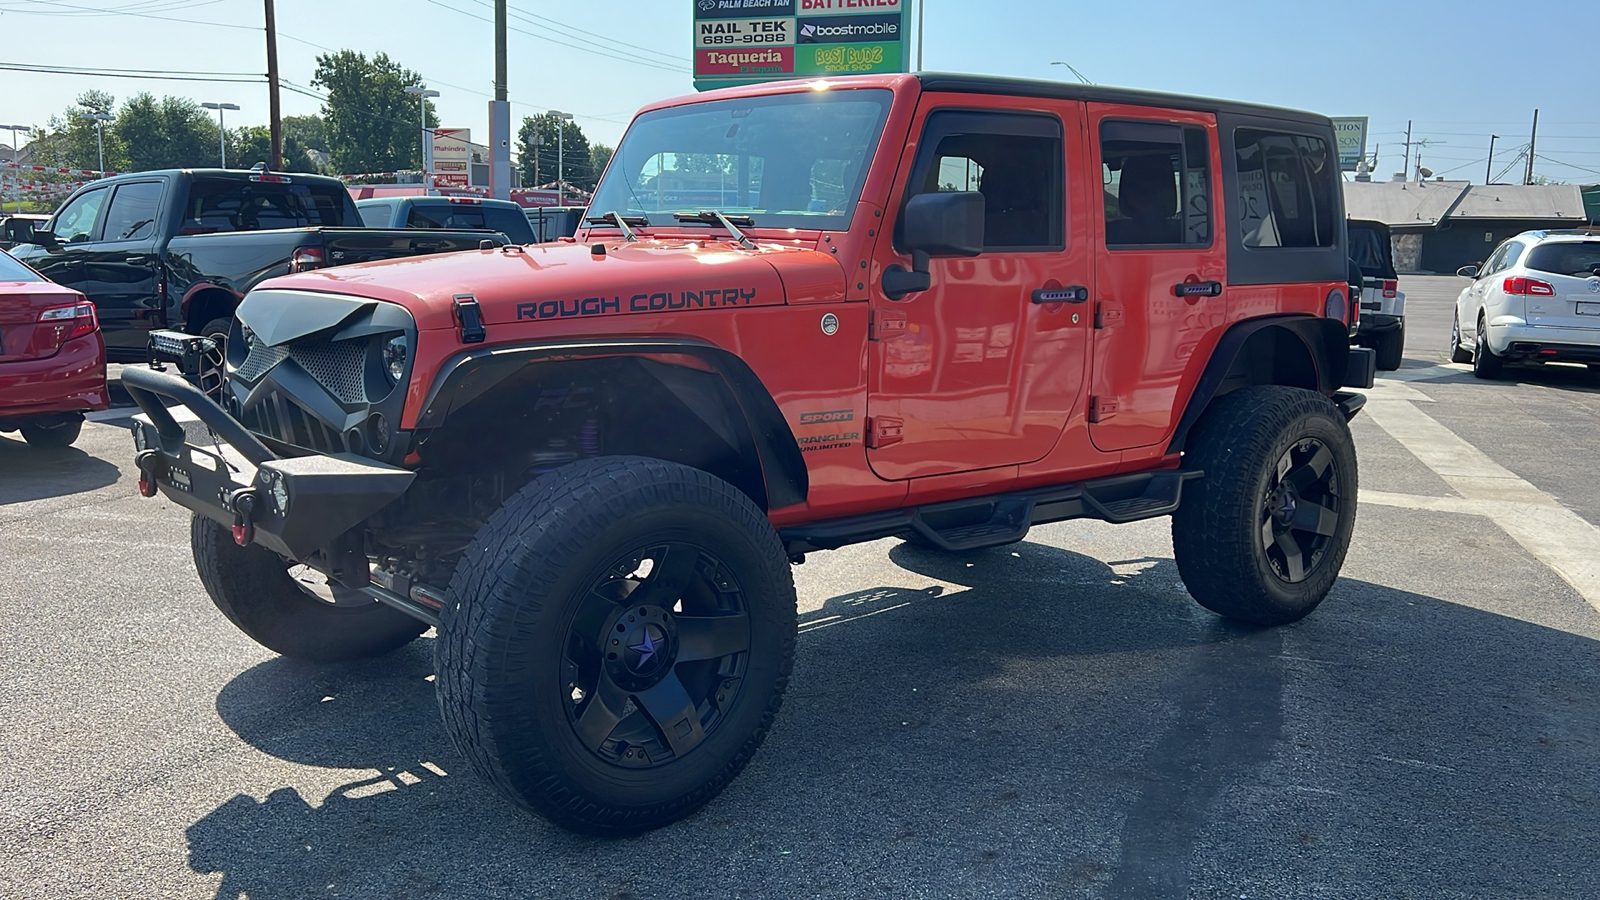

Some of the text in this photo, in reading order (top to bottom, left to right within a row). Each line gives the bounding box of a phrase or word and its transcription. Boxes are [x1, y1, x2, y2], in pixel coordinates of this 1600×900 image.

[718, 0, 741, 9] PALM
[742, 0, 771, 8] BEACH
[701, 20, 787, 35] NAIL TEK
[816, 23, 897, 36] boostmobile
[703, 33, 786, 44] 689-9088
[824, 63, 872, 72] SMOKE SHOP
[516, 287, 757, 321] ROUGH COUNTRY
[801, 411, 854, 424] SPORT
[800, 442, 851, 453] UNLIMITED
